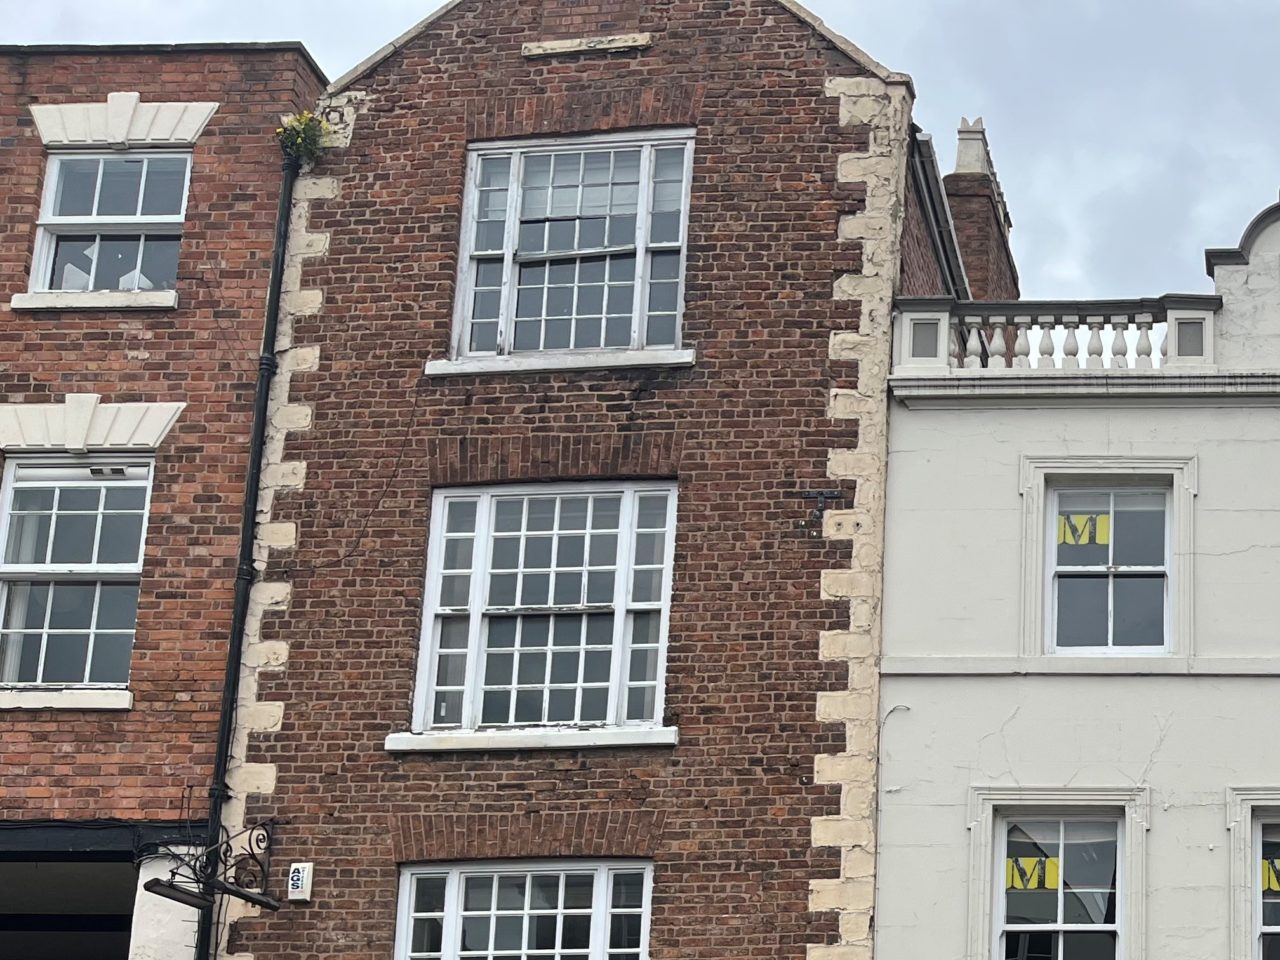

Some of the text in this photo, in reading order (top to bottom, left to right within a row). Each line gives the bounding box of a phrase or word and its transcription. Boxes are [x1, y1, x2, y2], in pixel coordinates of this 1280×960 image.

[1060, 514, 1100, 545] M
[290, 867, 301, 890] AGS
[1008, 857, 1048, 890] M
